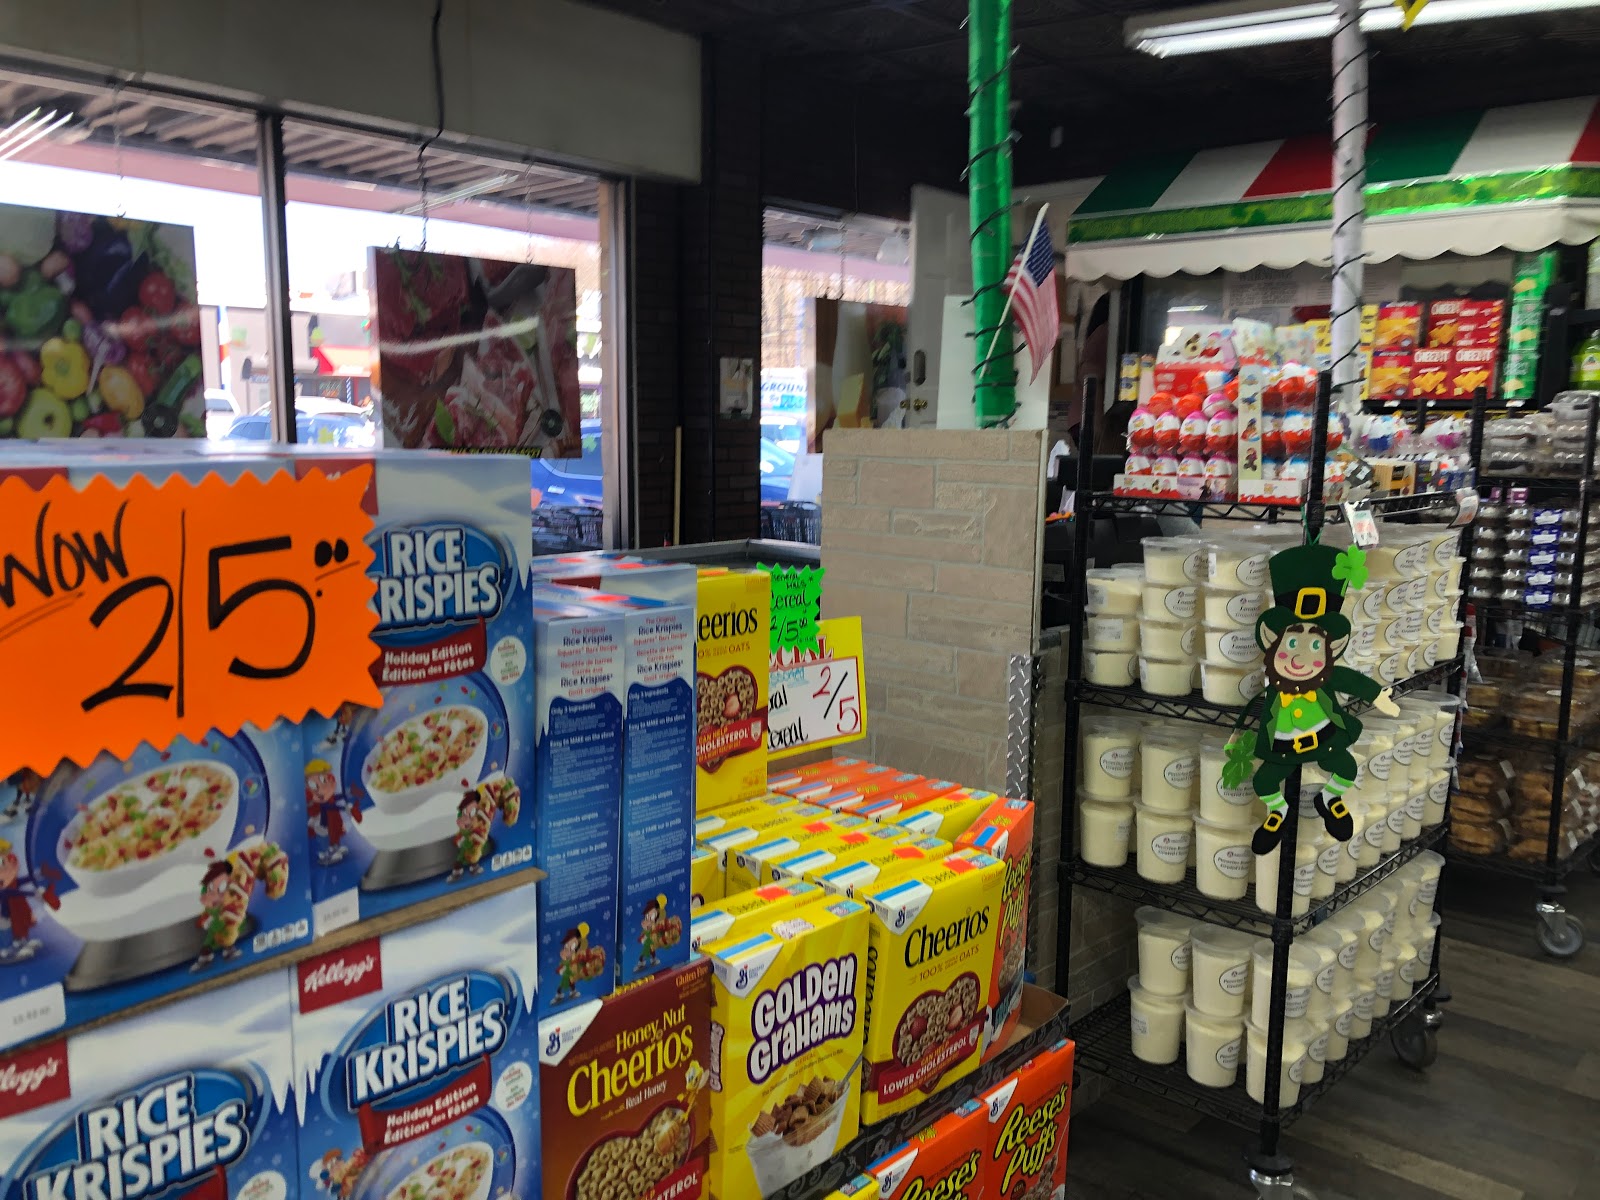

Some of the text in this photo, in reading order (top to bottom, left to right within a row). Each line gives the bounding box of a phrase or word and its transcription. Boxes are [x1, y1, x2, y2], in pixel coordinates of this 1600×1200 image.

[0, 499, 129, 608] NOW
[390, 529, 462, 577] RICE
[385, 642, 472, 666] Holiday Edition
[697, 607, 758, 642] eerios
[428, 665, 442, 676] des
[905, 905, 990, 968] Cheerios
[304, 955, 376, 993] Kellogg's
[394, 979, 466, 1044] RICE
[616, 1018, 660, 1055] Honey
[663, 1003, 685, 1031] Nut
[355, 1001, 505, 1102] KRISPIES
[567, 1024, 693, 1117] Cheerios
[883, 1072, 915, 1096] LOWER
[915, 1036, 968, 1079] CHOLESTEROL
[88, 1077, 191, 1159] RICE
[387, 1104, 433, 1128] Holiday
[435, 1082, 477, 1111] Edition
[431, 1112, 446, 1126] des
[626, 1091, 642, 1109] Real
[644, 1080, 667, 1104] Honey
[994, 1083, 1068, 1160] Reese's
[35, 1104, 244, 1200] KRISPIES
[1001, 1122, 1058, 1195] Puffs
